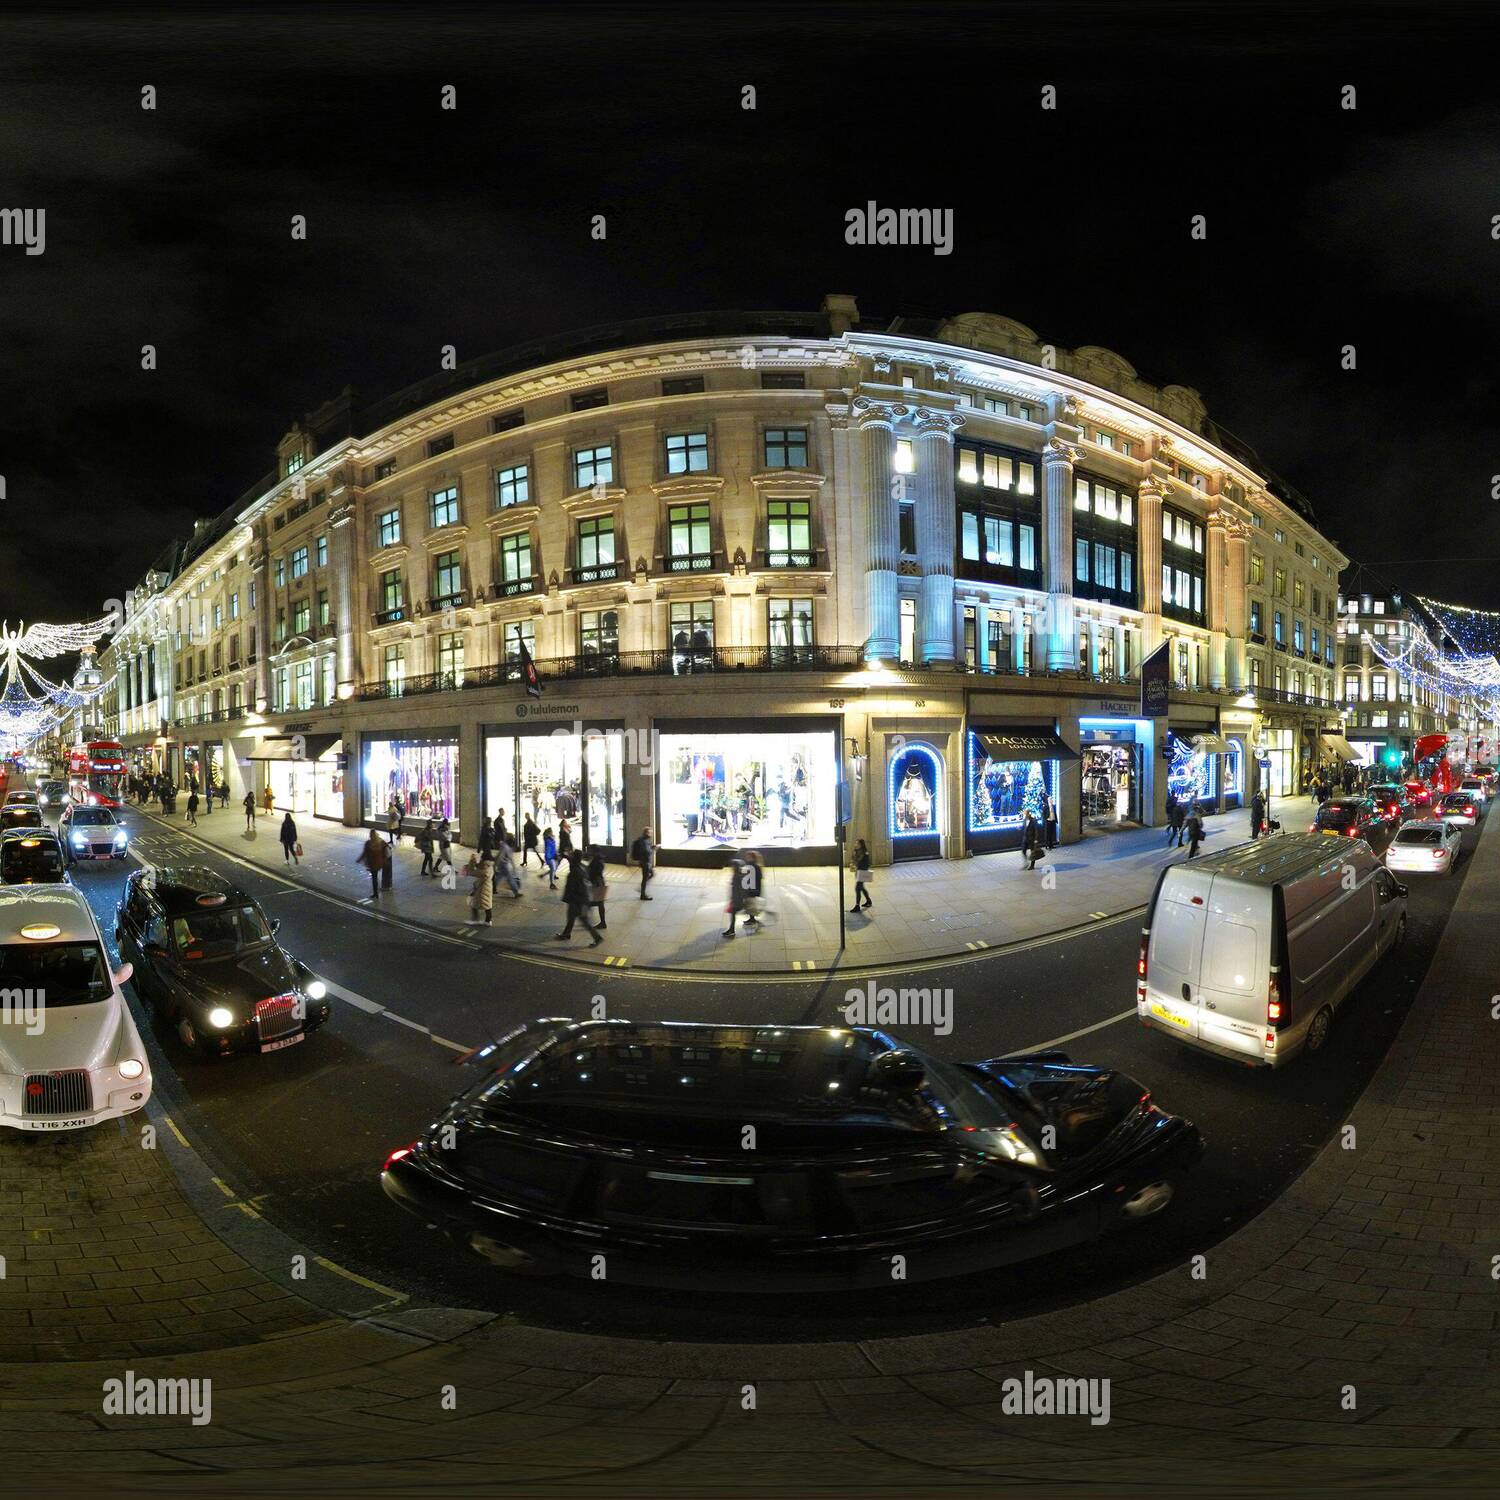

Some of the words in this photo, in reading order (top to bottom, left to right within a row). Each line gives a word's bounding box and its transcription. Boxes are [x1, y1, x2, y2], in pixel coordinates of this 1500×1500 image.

[530, 704, 579, 715] lululemon
[1100, 701, 1138, 712] HACKETT
[983, 735, 1057, 745] HACKETT
[62, 1119, 86, 1127] XXH
